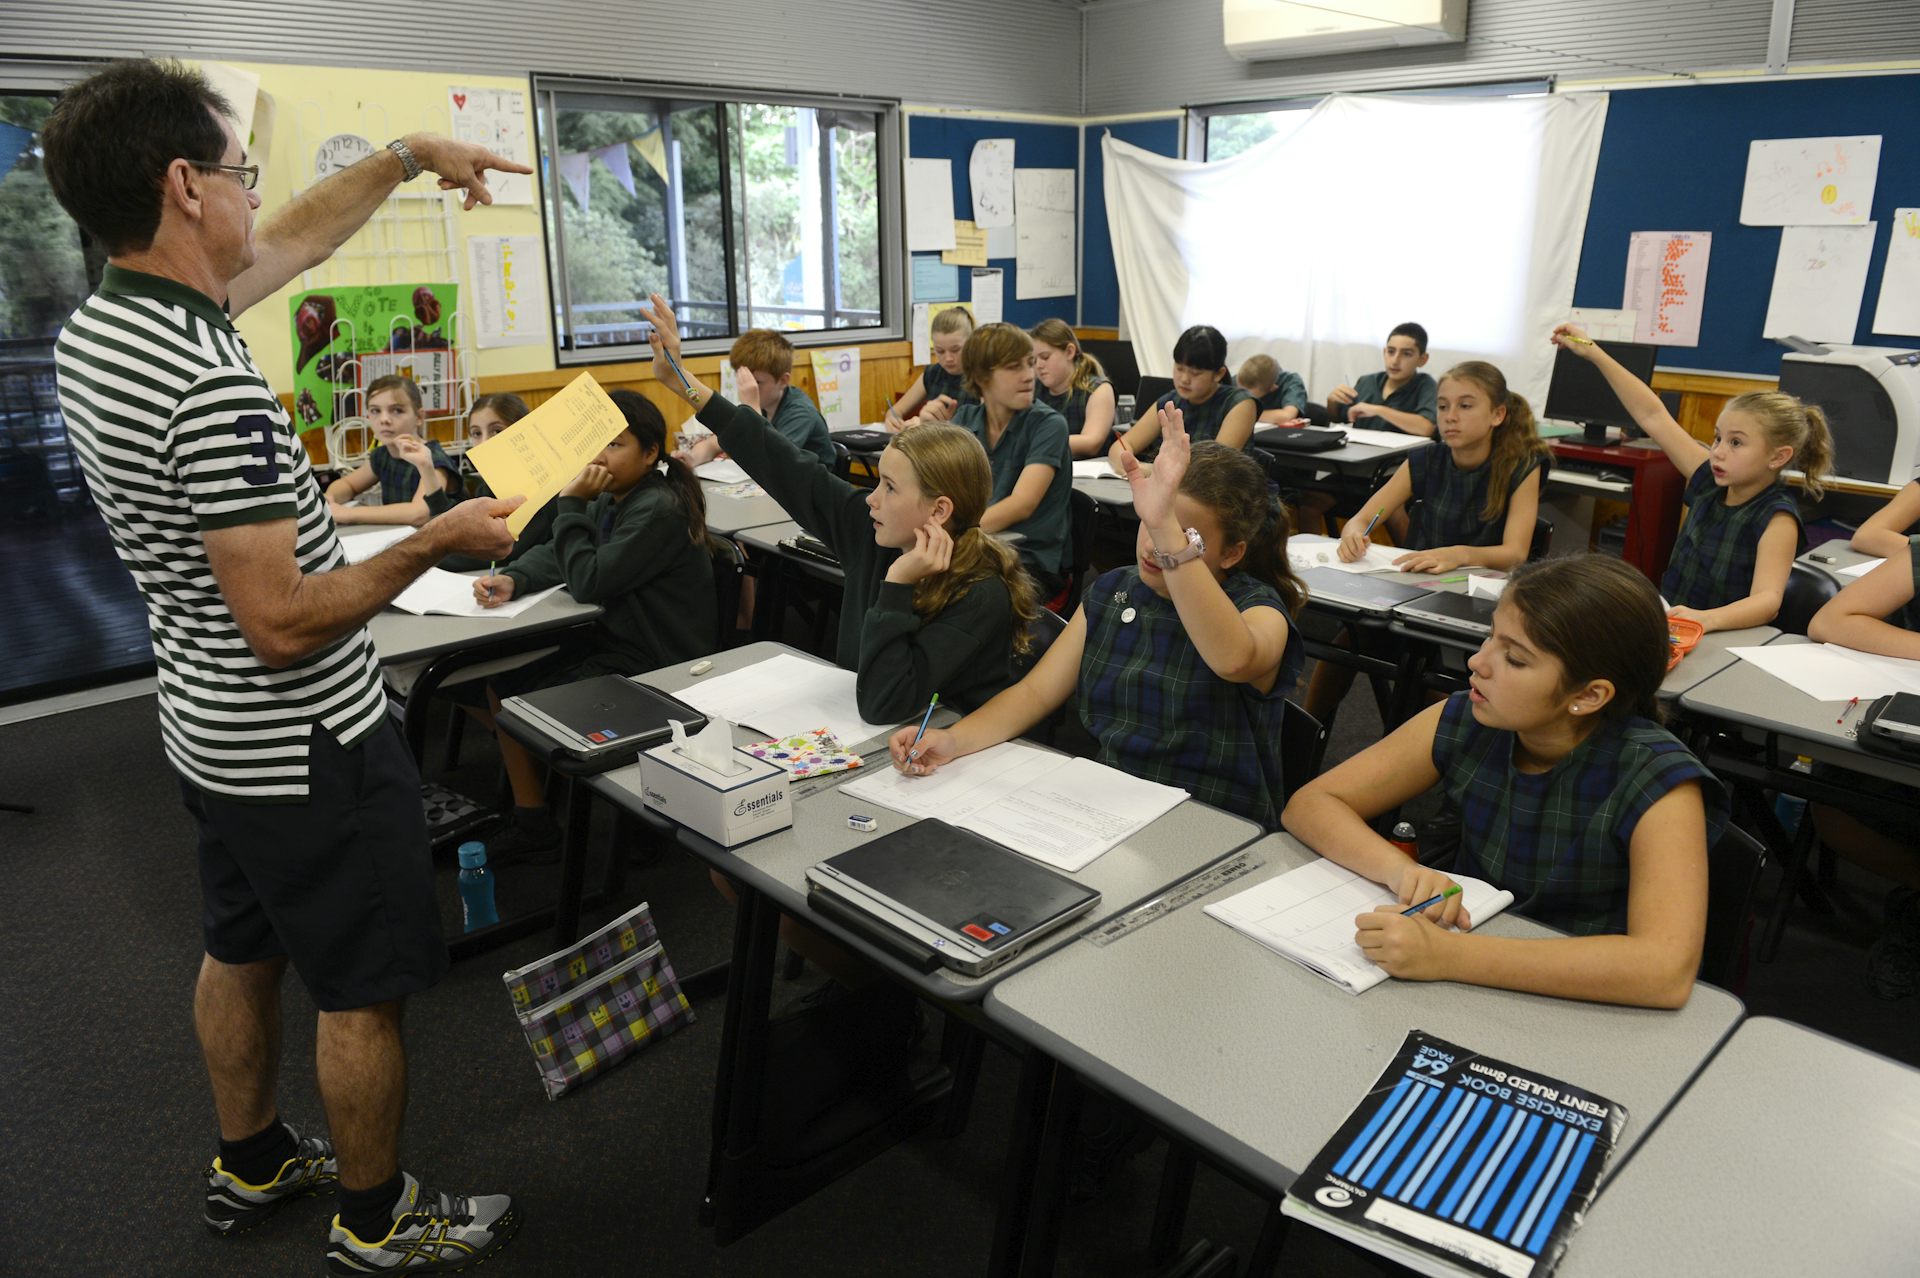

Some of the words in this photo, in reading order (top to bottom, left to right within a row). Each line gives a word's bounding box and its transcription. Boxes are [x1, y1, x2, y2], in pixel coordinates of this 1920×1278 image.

[333, 140, 340, 151] 11
[342, 137, 353, 149] 12
[356, 140, 361, 152] 1
[319, 162, 327, 173] 9
[363, 286, 382, 297] GO
[336, 293, 398, 318] VOTE
[840, 353, 851, 373] a
[433, 373, 441, 409] BULDOZER
[235, 414, 279, 486] 3
[733, 790, 783, 817] Essentials
[1412, 1054, 1450, 1076] 64
[1420, 1045, 1456, 1064] PAGE
[1470, 1062, 1507, 1081] 8mm
[1458, 1073, 1513, 1100] BOOK
[1507, 1074, 1560, 1102] RULED
[1515, 1093, 1603, 1132] EXERCISE
[1560, 1094, 1609, 1118] FEINT
[1325, 1174, 1368, 1198] OLYMPIC
